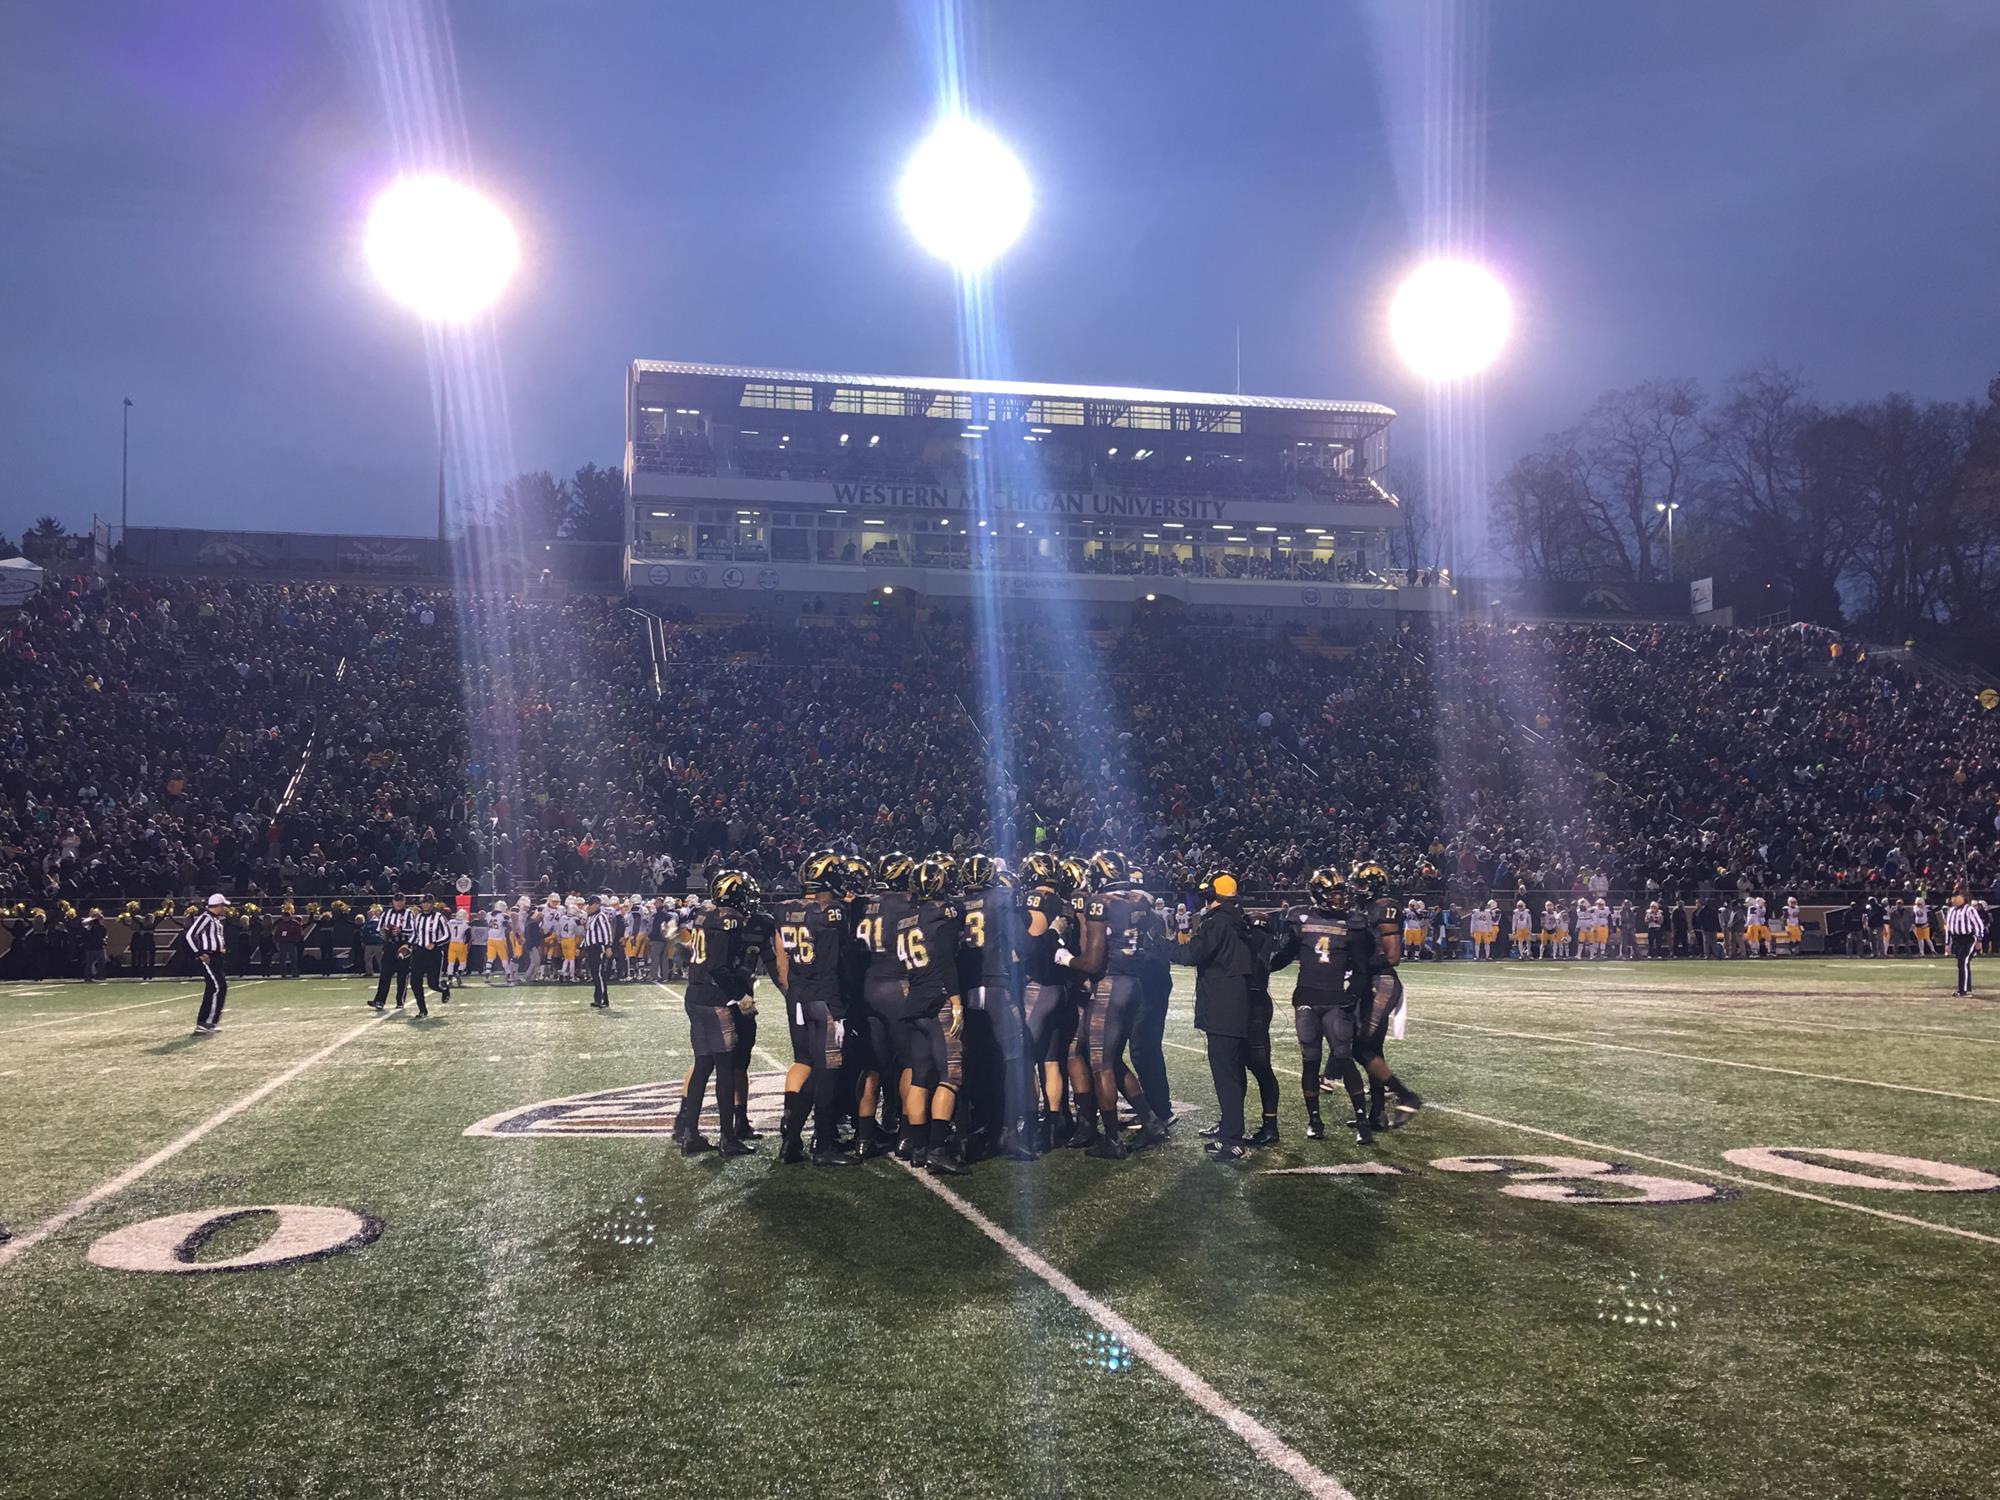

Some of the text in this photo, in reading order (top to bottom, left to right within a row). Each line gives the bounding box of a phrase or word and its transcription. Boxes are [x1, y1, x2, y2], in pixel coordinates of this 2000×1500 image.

[832, 483, 949, 508] WESTERN
[1093, 494, 1227, 519] UNIVERSITY
[1026, 895, 1041, 908] 58
[1071, 897, 1084, 910] 50
[827, 908, 842, 921] 26
[1089, 902, 1104, 916] 33
[1385, 907, 1398, 919] 17
[562, 922, 569, 934] 4
[723, 918, 738, 931] 30
[453, 925, 459, 938] 1
[896, 927, 930, 971] 46
[1313, 936, 1331, 963] 4
